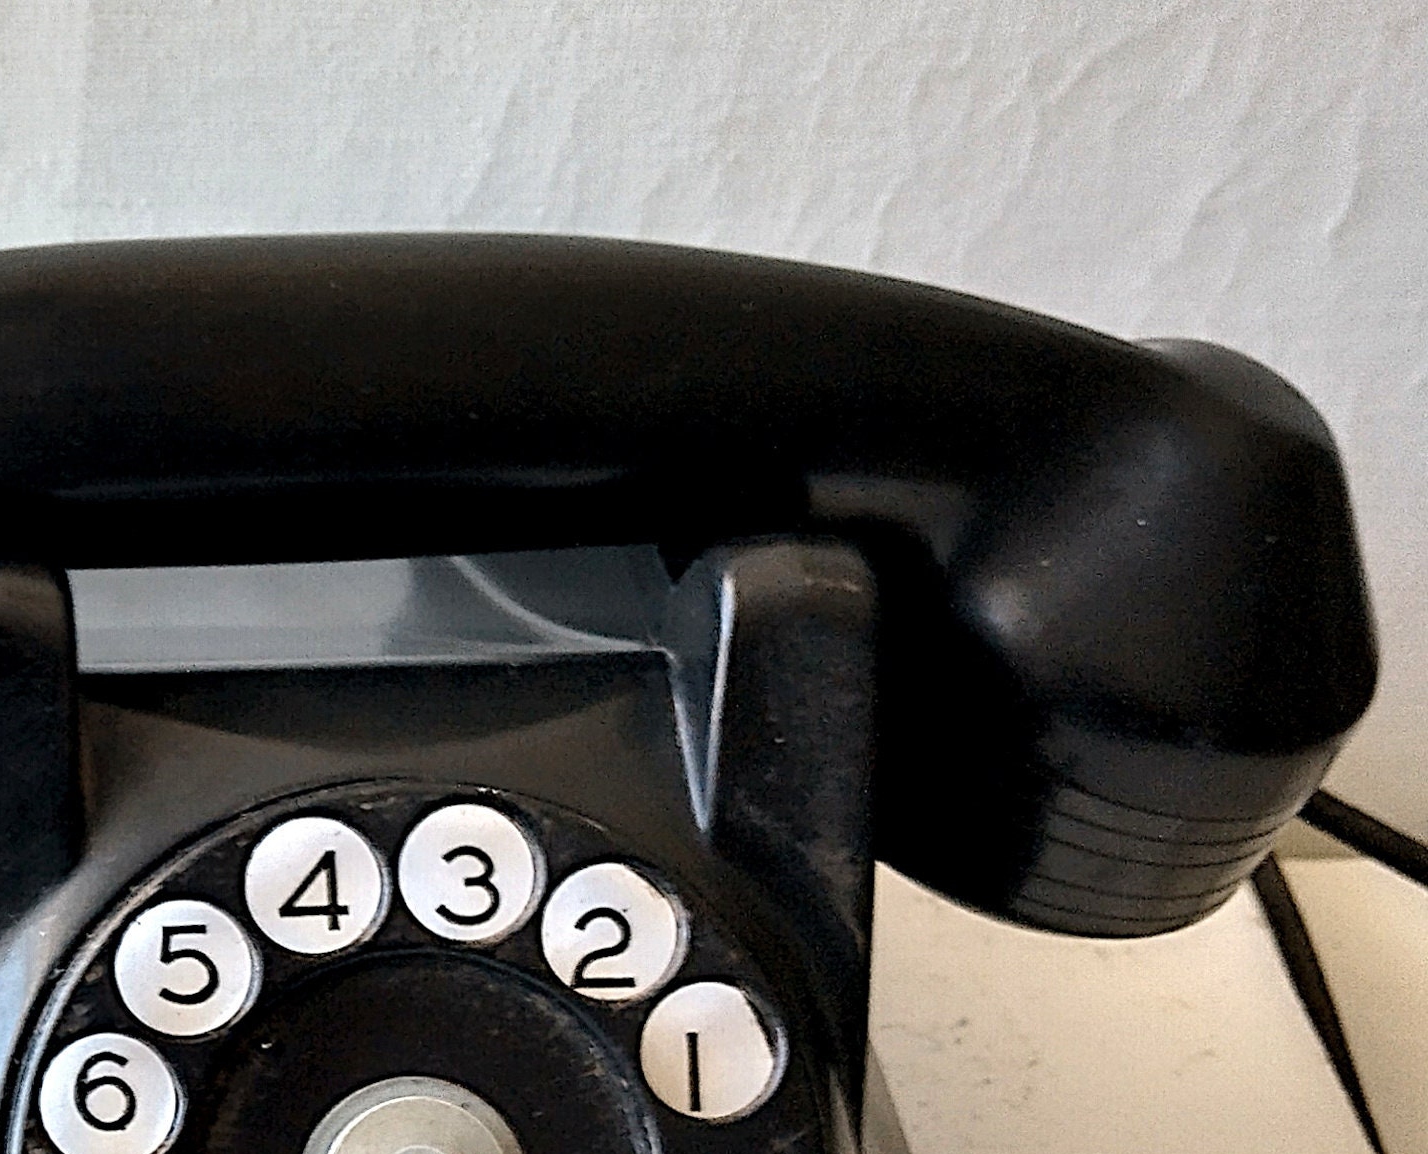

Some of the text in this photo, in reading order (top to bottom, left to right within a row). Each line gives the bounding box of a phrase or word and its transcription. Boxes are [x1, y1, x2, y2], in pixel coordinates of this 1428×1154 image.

[279, 850, 349, 930] 4
[436, 846, 499, 925] 3
[159, 925, 219, 1005] 5
[573, 907, 636, 989] 2
[75, 1052, 136, 1131] 6
[686, 1032, 701, 1112] 1
